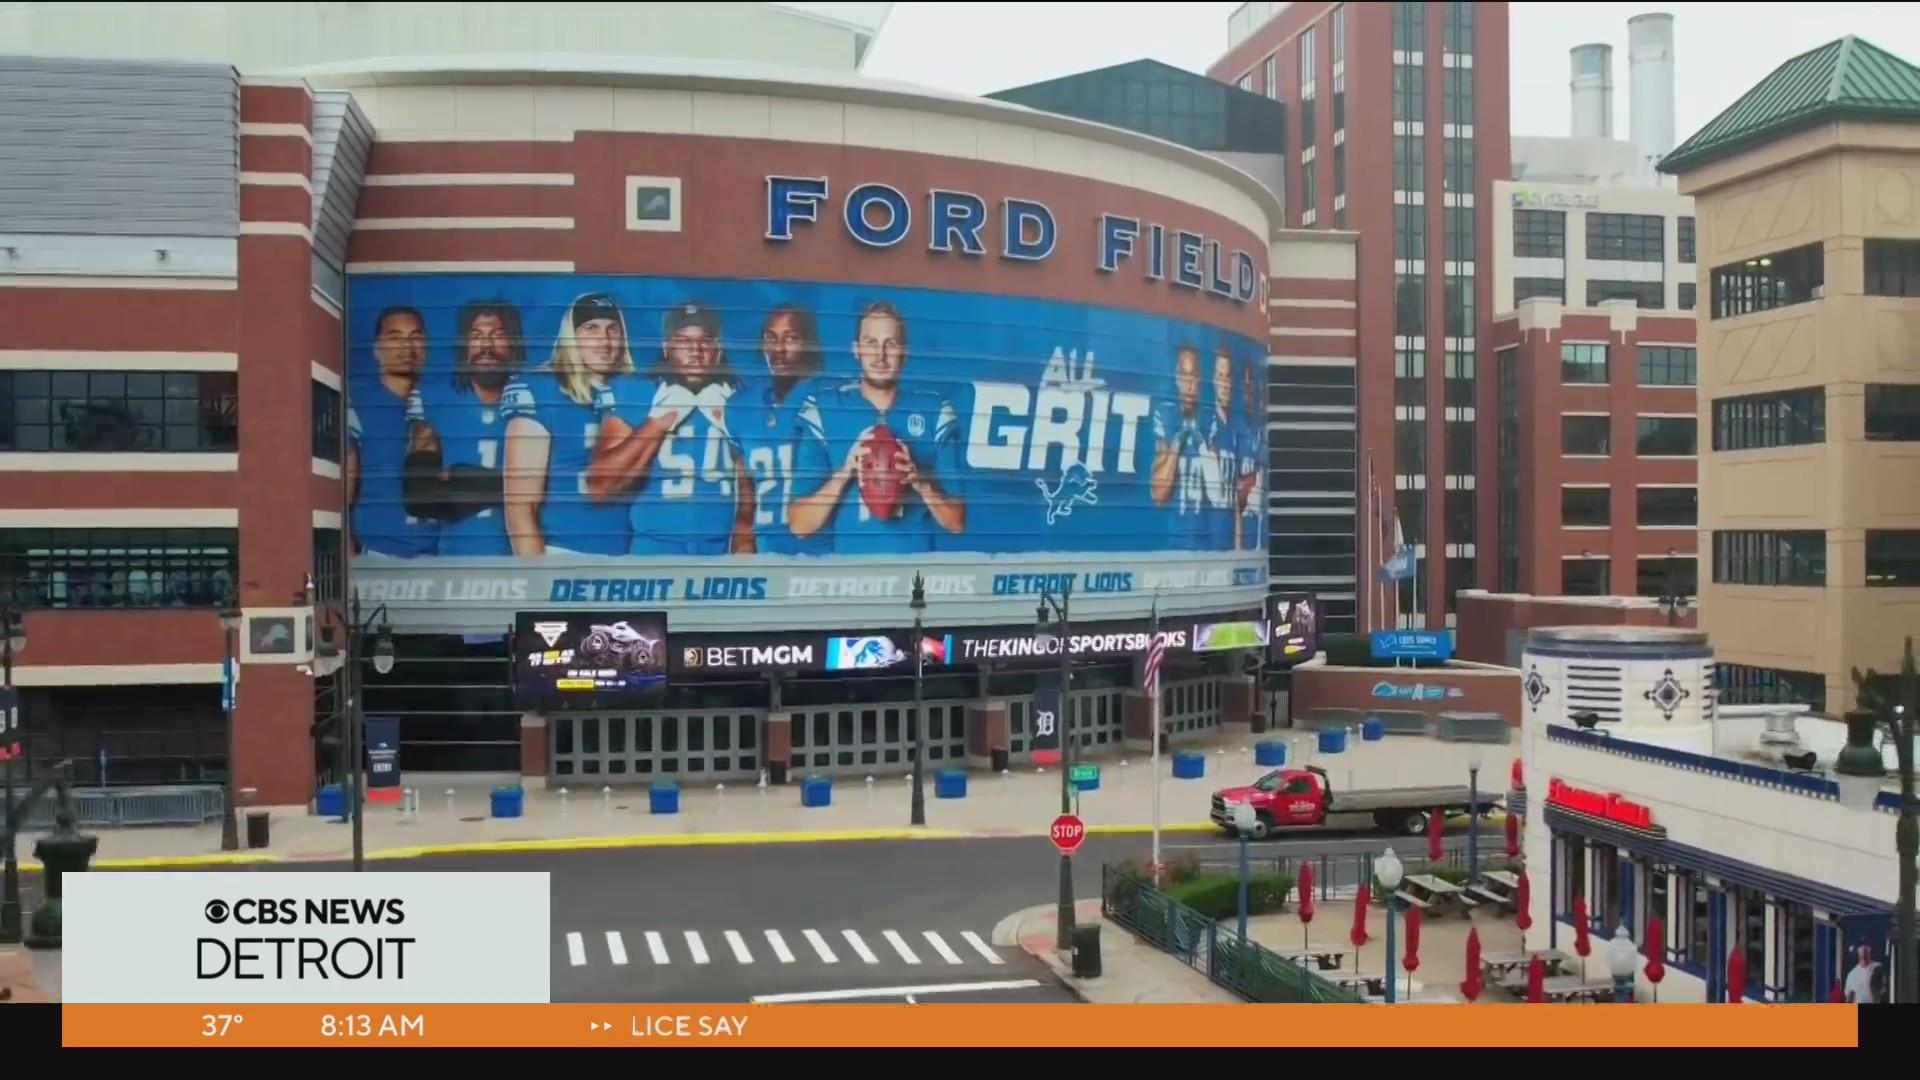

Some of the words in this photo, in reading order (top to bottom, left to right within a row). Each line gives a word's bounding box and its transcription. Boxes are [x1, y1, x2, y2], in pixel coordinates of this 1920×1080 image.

[765, 175, 1057, 261] FORD
[1096, 211, 1256, 303] FIELD
[1040, 346, 1107, 391] ALL
[966, 381, 1152, 473] GRIT
[749, 444, 793, 525] 21
[549, 578, 675, 602] DETROIT
[684, 576, 768, 601] LIONS
[789, 577, 900, 597] DETROIT
[992, 573, 1077, 596] DETROIT
[1085, 571, 1133, 591] LIONS
[707, 645, 813, 666] BETMGM
[1052, 825, 1082, 838] STOP
